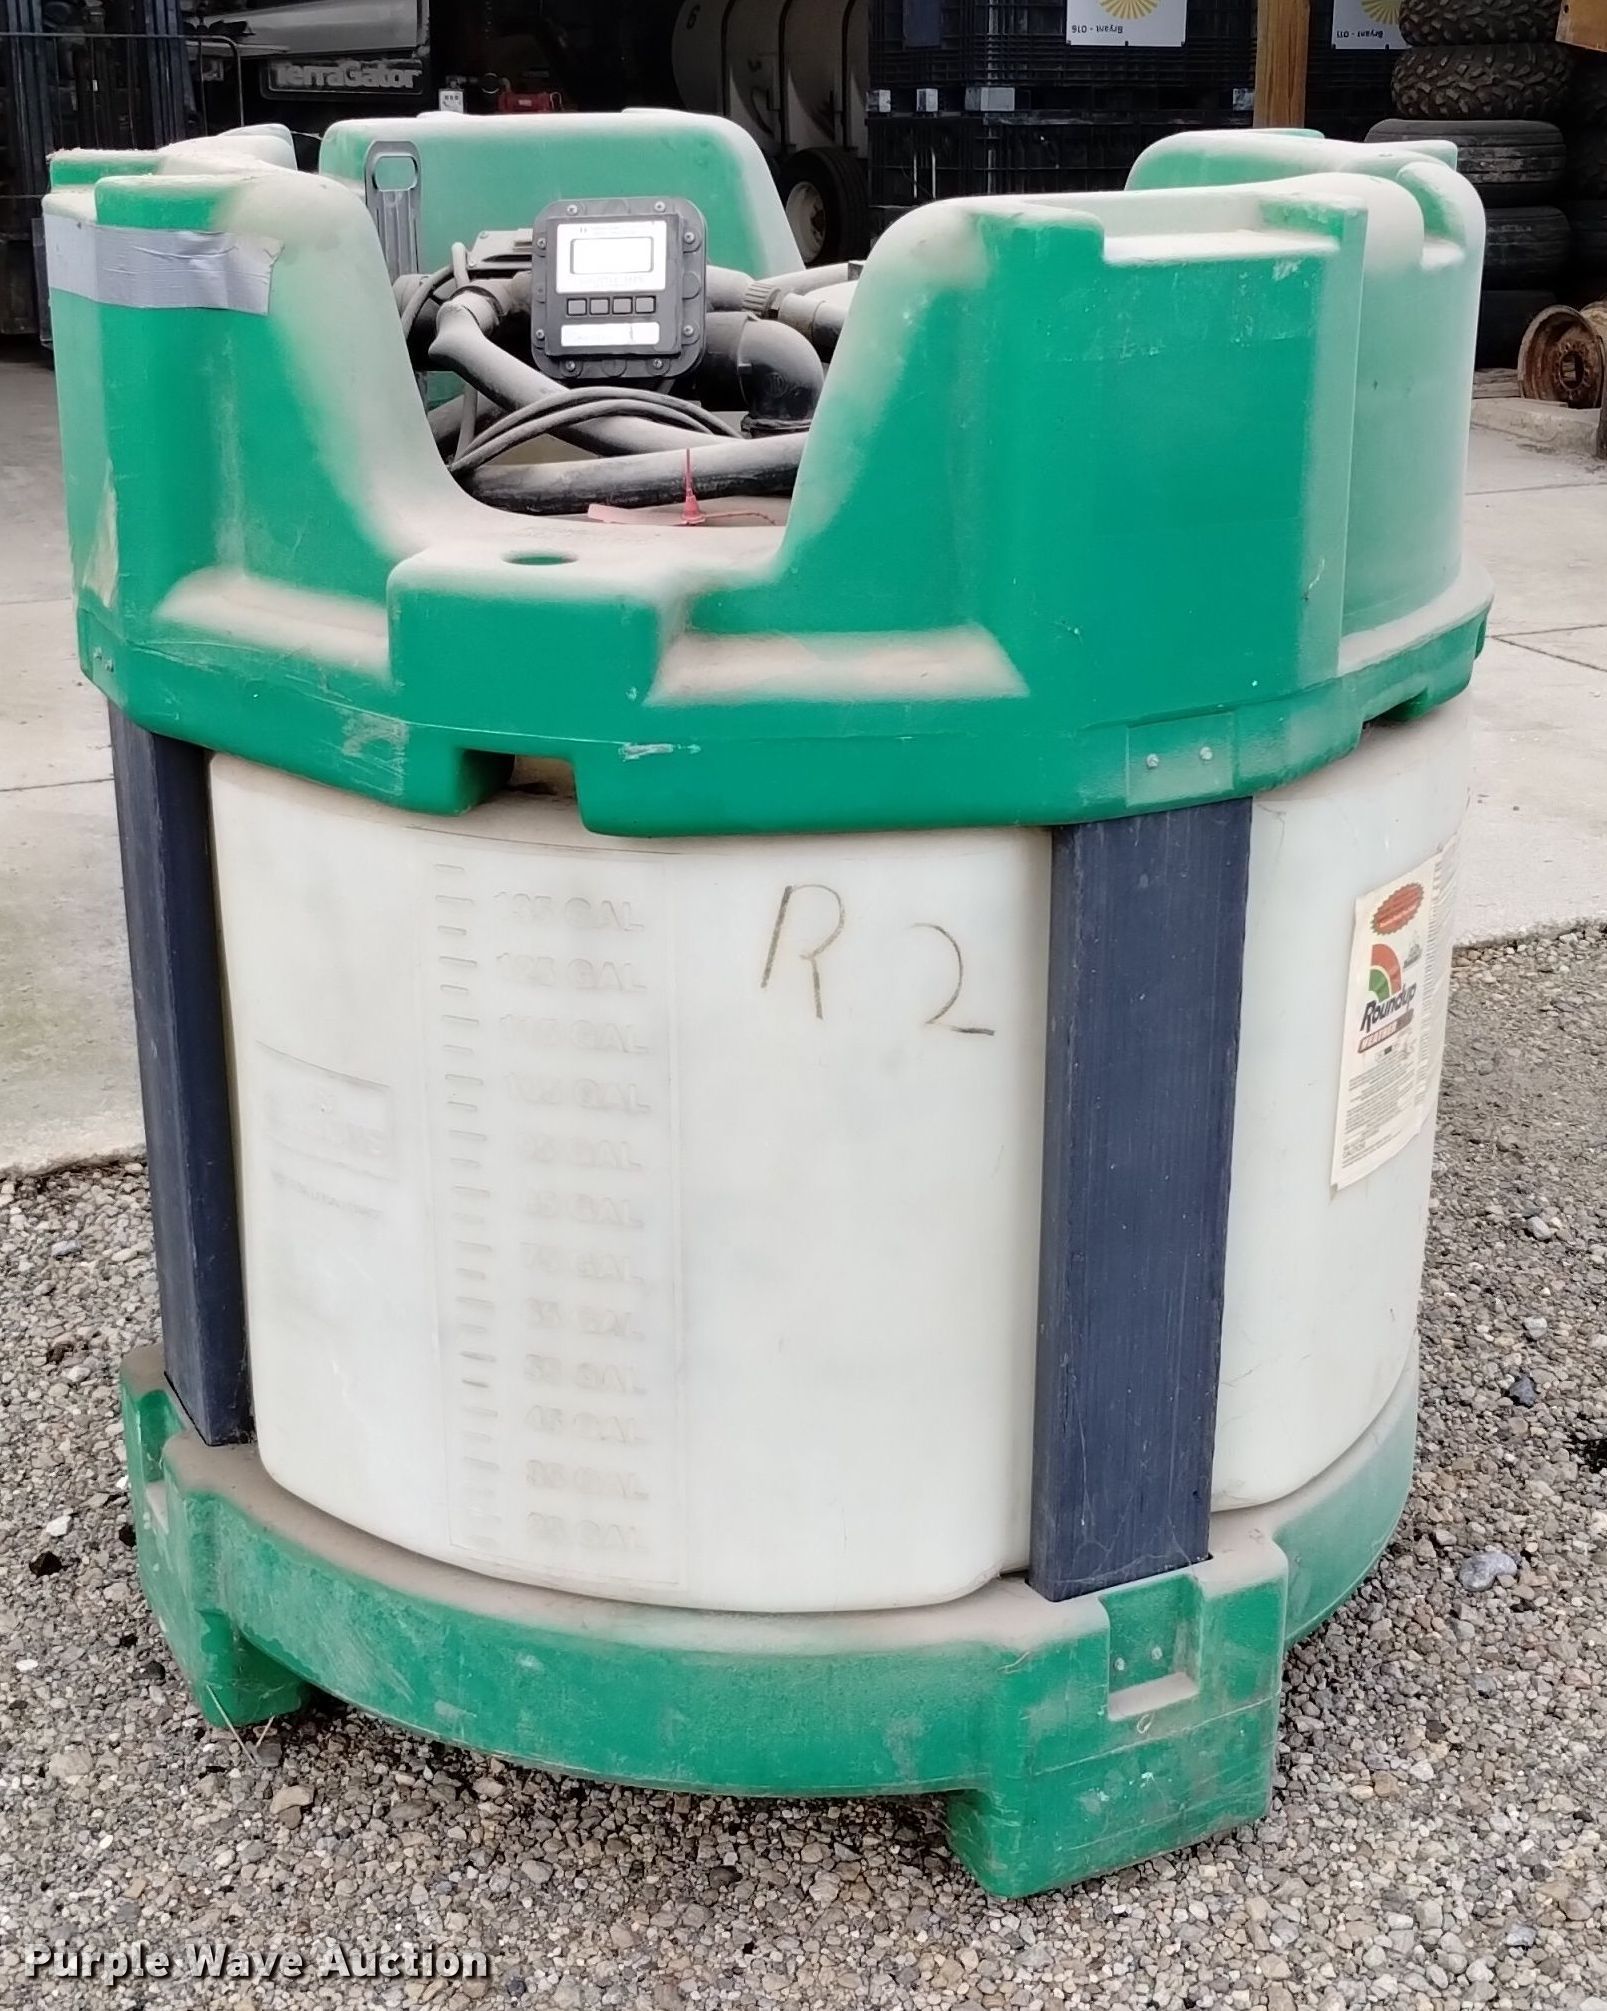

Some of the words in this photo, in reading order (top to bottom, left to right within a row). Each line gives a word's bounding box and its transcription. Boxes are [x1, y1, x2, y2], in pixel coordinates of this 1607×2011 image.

[1071, 24, 1088, 34] 016
[1096, 24, 1124, 34] Bryant
[1357, 29, 1384, 39] Bryant
[272, 58, 422, 88] TerraGator
[563, 896, 646, 931] GAL
[566, 957, 648, 993] GAL
[760, 884, 845, 1020] R
[904, 922, 995, 1036] 2
[1360, 983, 1417, 1033] Roundup
[568, 1018, 652, 1054] GAL
[574, 1077, 651, 1114] GAL
